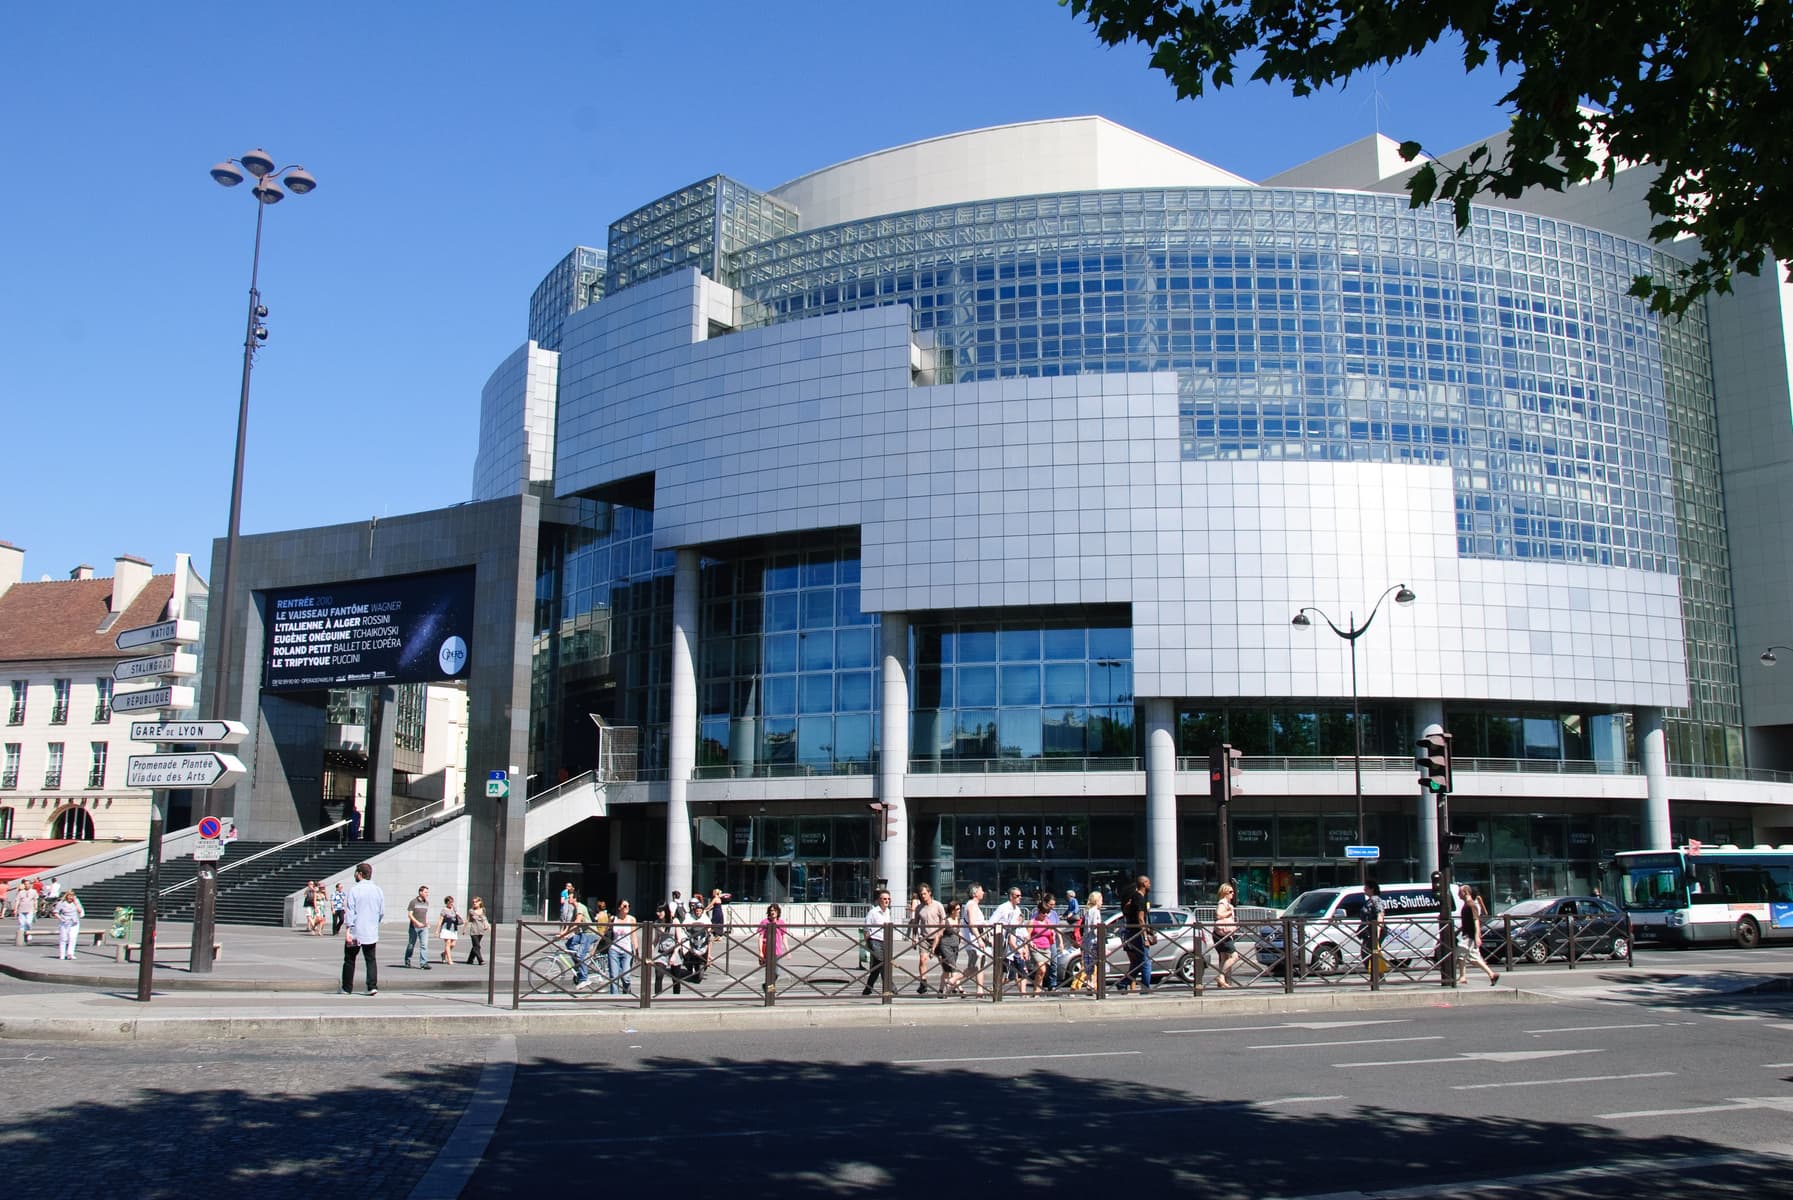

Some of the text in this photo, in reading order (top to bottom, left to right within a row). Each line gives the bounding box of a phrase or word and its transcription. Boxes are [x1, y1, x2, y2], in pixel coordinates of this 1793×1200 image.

[277, 596, 314, 608] RENTRÉE
[276, 601, 401, 620] LE VAISSEAU FANTÔME WAGNER
[275, 615, 390, 632] L'ITALIENNE À ALGER ROSSINI
[151, 627, 175, 639] NATION
[274, 626, 399, 644] EUGÈNE ONÉGUINE TCHAIKOVSKI
[273, 637, 402, 656] ROLAND PETIT BALLET DE L'OPÉRA
[130, 658, 172, 675] STALINGRAD
[272, 654, 361, 668] LE TRIPTYQUE PUCCINI
[126, 691, 169, 706] RÉPUBLIQUE
[135, 726, 162, 736] GARE
[178, 726, 204, 736] LYON
[133, 758, 213, 770] Promenade Plantée
[132, 771, 206, 782] Viaduc des Arts
[965, 826, 1078, 836] LIBRAIRIE
[986, 839, 1055, 850] OPERA
